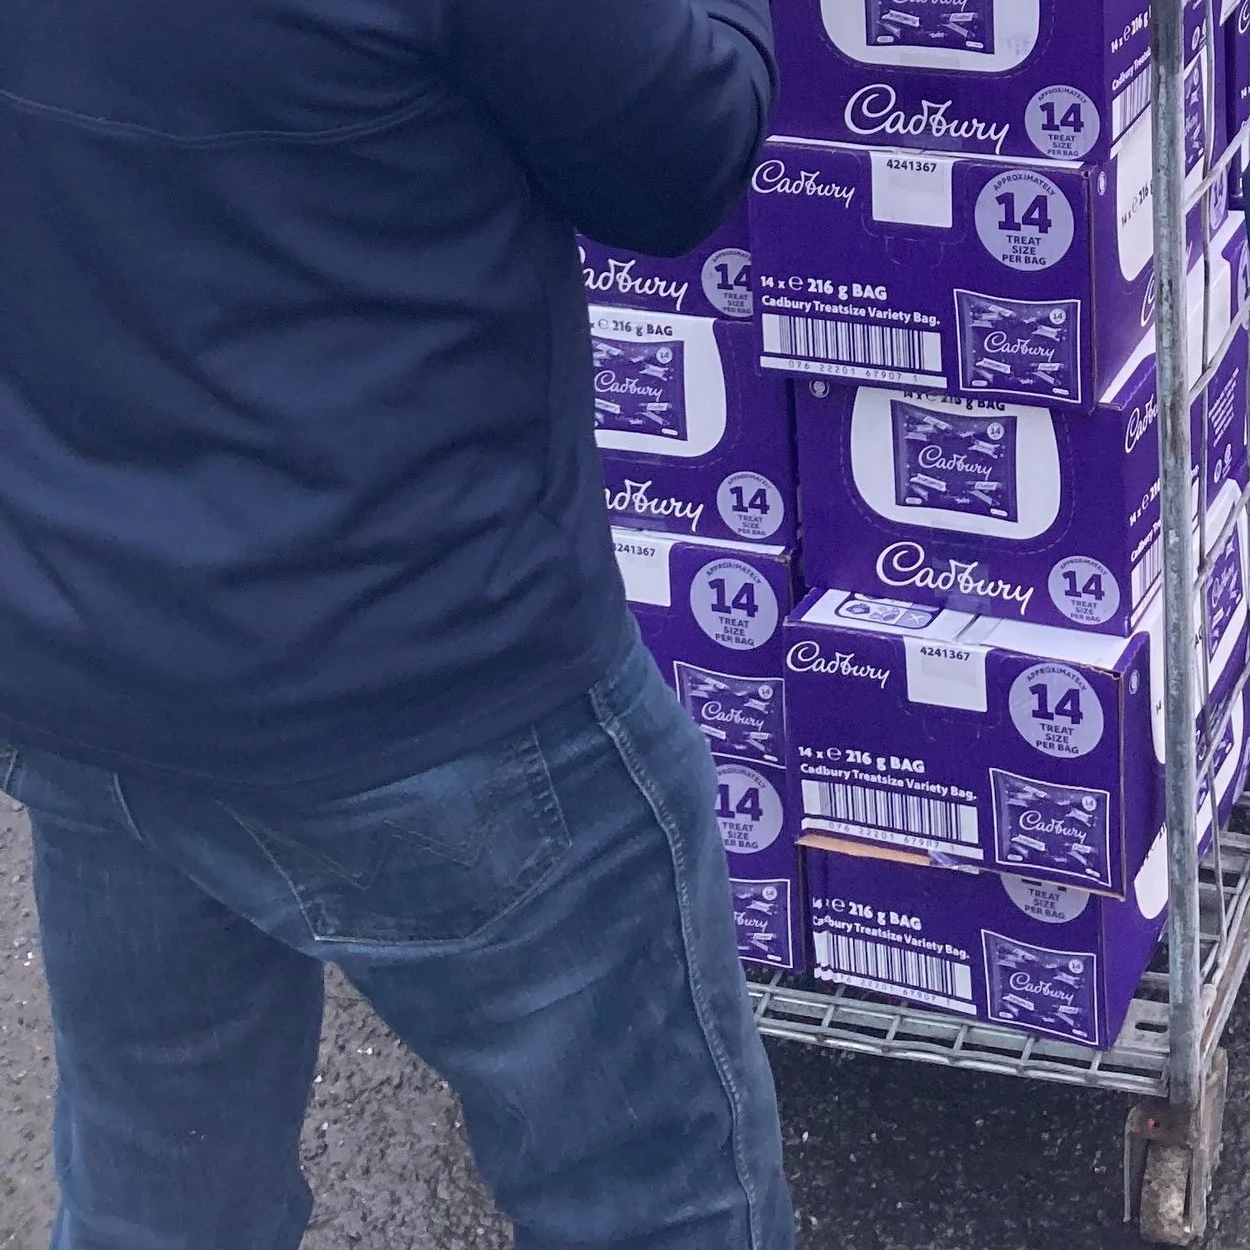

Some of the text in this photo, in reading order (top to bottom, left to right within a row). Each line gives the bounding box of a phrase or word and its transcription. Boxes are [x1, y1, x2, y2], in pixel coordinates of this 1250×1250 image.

[844, 83, 1010, 155] Cadbury
[1040, 102, 1084, 133] 14
[886, 159, 937, 173] 4241367
[751, 159, 855, 208] Cadbury
[993, 174, 1057, 196] APPROXIMATELY
[995, 192, 1052, 234] 14
[1006, 235, 1042, 246] TREAT
[1011, 245, 1037, 255] SIZE
[1002, 253, 1047, 266] PER BAG
[714, 263, 752, 291] 14
[760, 275, 887, 301] 14 216 BAG
[762, 296, 940, 327] Cadbury Treatsize Variety Bag.
[612, 320, 673, 336] 216 BAG
[984, 330, 1055, 361] Cadbury
[595, 370, 663, 401] Cadbury
[819, 363, 903, 380] 22201 67907
[918, 444, 993, 479] Cadbury
[730, 486, 770, 514] 14
[876, 541, 1035, 615] Cadbury
[1061, 569, 1105, 601] 14
[709, 577, 758, 617] 14
[718, 616, 749, 628] TREAT
[786, 640, 891, 689] Cadbury
[920, 647, 970, 661] 4241367
[700, 700, 765, 731] Cadbury
[1029, 683, 1084, 725] 14
[1040, 723, 1074, 736] TREAT
[1045, 733, 1069, 745] SIZE
[799, 747, 926, 774] 14 216 BAG
[1036, 740, 1080, 755] PER BAG
[800, 763, 977, 801] Cadbury Treatsize Variety Bag.
[1019, 810, 1087, 842] Cadbury
[1029, 888, 1060, 902] TREAT
[1033, 898, 1056, 909] SIZE
[848, 901, 922, 931] 216 BAG
[853, 922, 902, 942] Treatsize
[903, 931, 943, 952] Variety
[1009, 972, 1074, 1005] Cadbury
